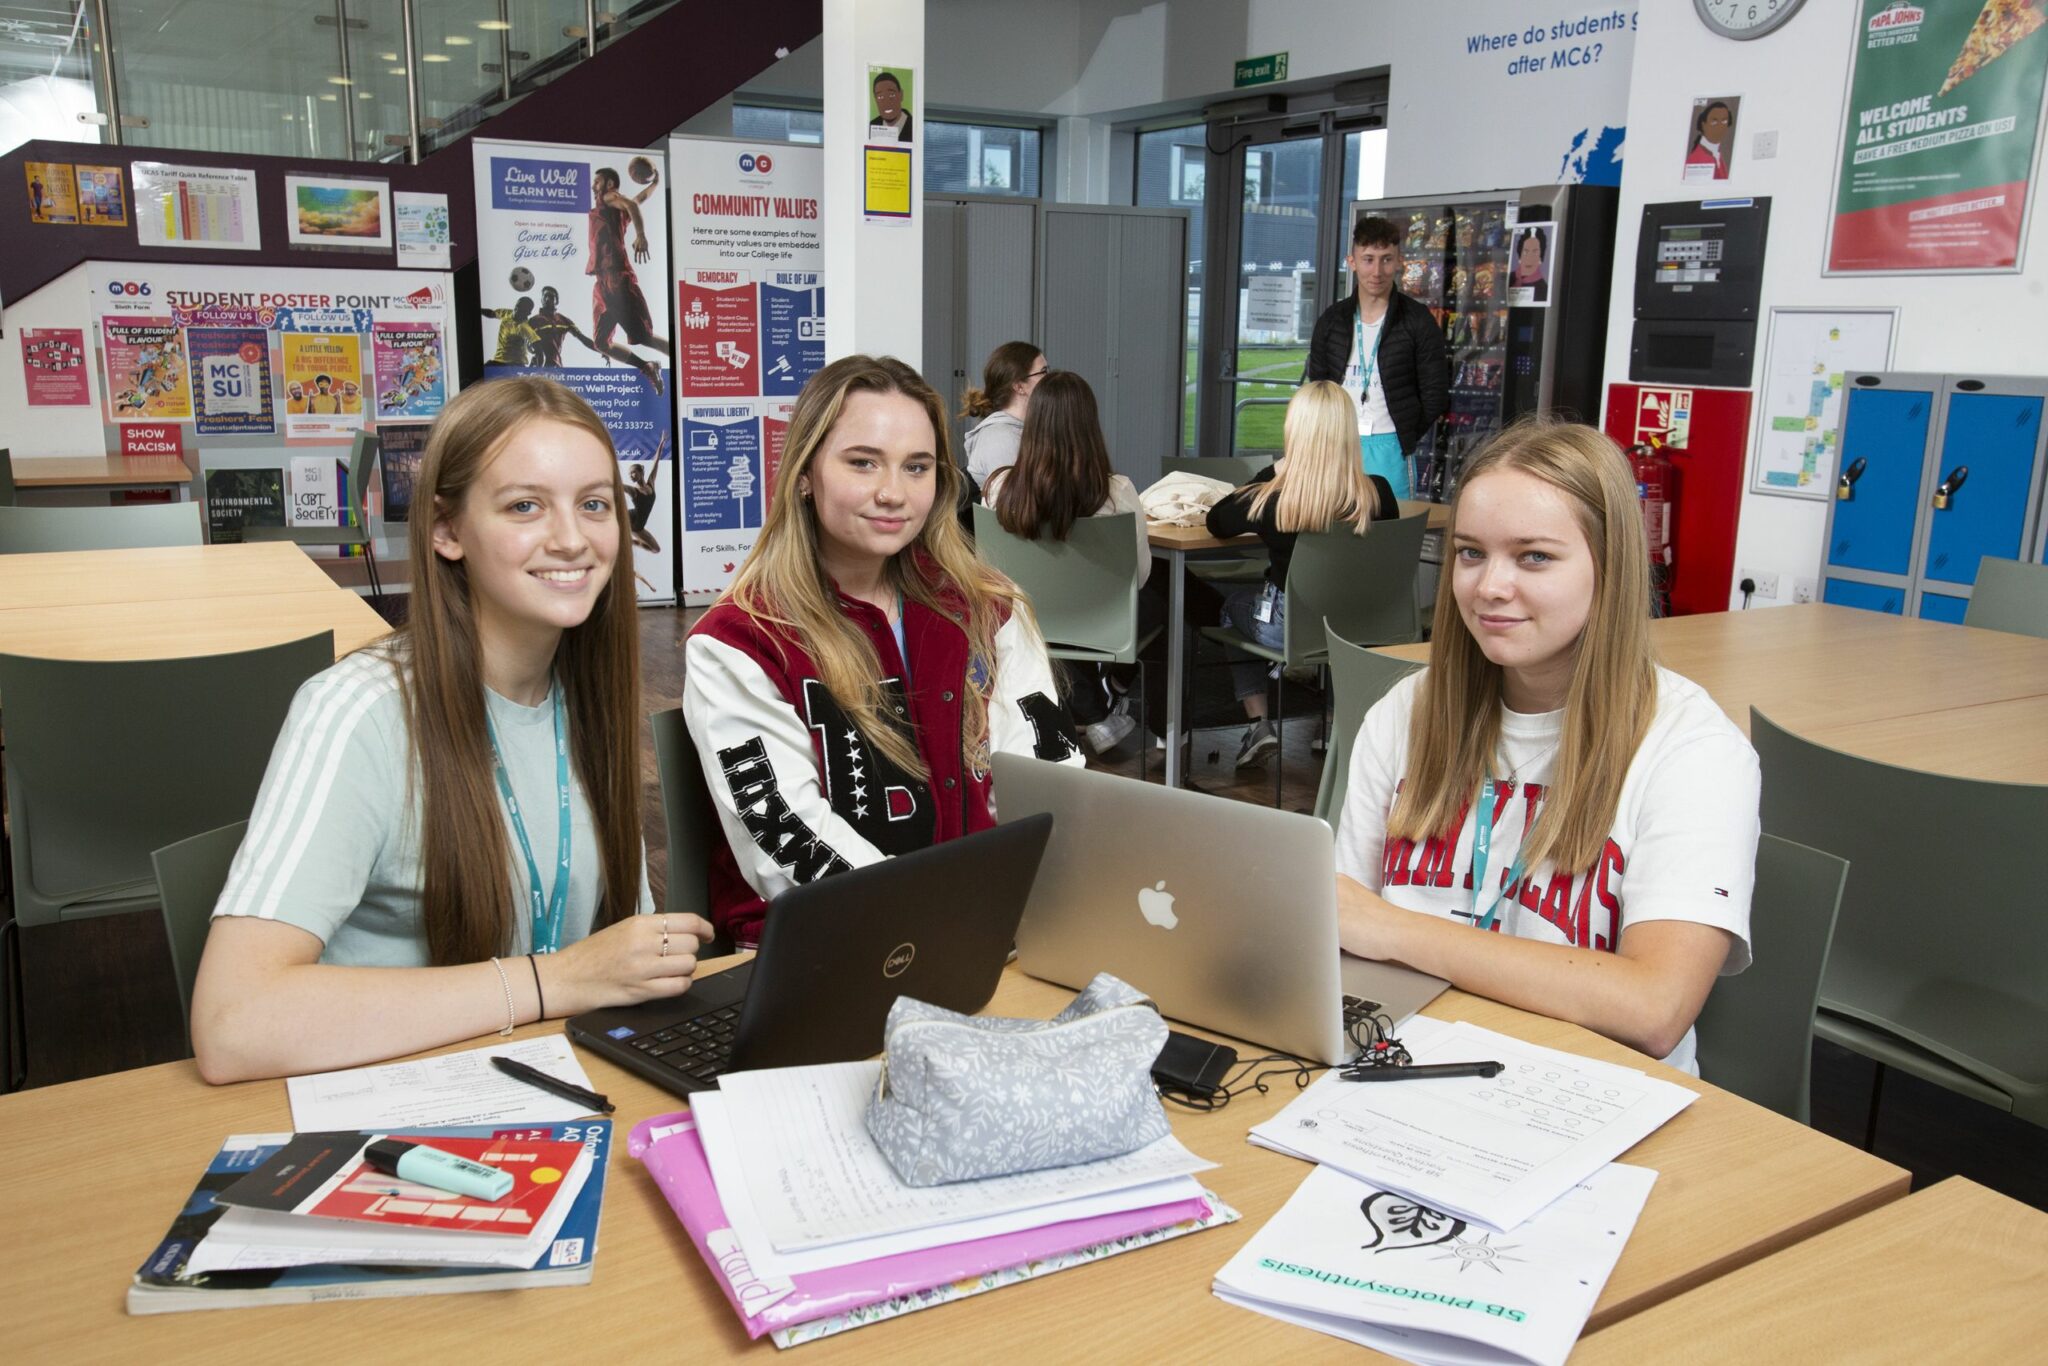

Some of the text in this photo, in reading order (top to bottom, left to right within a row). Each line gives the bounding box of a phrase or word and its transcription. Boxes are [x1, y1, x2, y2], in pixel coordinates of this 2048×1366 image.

[1730, 4, 1738, 18] 7
[1748, 5, 1757, 20] 6
[1871, 12, 1891, 29] PAPA
[1467, 33, 1518, 54] Where
[1523, 25, 1545, 44] do
[1550, 10, 1625, 40] students
[1867, 36, 1894, 49] BETTER
[1508, 43, 1603, 76] after MC6?
[1237, 63, 1270, 80] Fire exit
[1859, 94, 1933, 127] WELCOME
[1856, 105, 1968, 146] ALL STUDENTS
[1857, 147, 1878, 162] HAVE
[1879, 146, 1887, 158] A
[1887, 141, 1909, 157] FREE
[1910, 133, 1947, 151] MEDIUM
[1948, 127, 1975, 144] PIZZA
[1977, 124, 1991, 138] ON
[179, 171, 197, 179] Quick
[504, 166, 578, 186] Live Well
[505, 186, 578, 199] LEARN WELL
[693, 193, 817, 220] COMMUNITY VALUES
[518, 228, 572, 243] Come and
[693, 226, 713, 235] Here
[752, 230, 790, 239] examples
[791, 230, 799, 238] of
[690, 238, 735, 248] community
[778, 242, 820, 250] embedded
[514, 243, 577, 262] Give it a Go
[720, 250, 735, 258] into
[751, 250, 779, 261] College
[780, 250, 793, 259] life
[697, 271, 738, 284] DEMOCRACY
[776, 272, 818, 285] RULE OF LAW
[166, 290, 391, 310] STUDENT POSTER POINT
[196, 312, 253, 320] FOLLOW US
[304, 345, 322, 353] LITTLE
[324, 346, 344, 354] YELLOW
[210, 364, 240, 378] MC
[329, 364, 352, 373] PEOPLE
[550, 374, 566, 382] out
[592, 373, 620, 382] about
[621, 374, 636, 382] the
[212, 380, 242, 397] SU
[585, 384, 606, 393] Well
[614, 398, 630, 408] Pod
[692, 407, 750, 418] INDIVIDUAL LIBERTY
[624, 422, 654, 430] 333725
[126, 428, 166, 439] SHOW
[128, 442, 176, 452] RACISM
[616, 448, 642, 456] .ac.uk
[304, 474, 318, 482] SU
[210, 496, 273, 507] ENVIRONMENTAL
[294, 492, 326, 507] LGBT
[211, 508, 243, 518] SOCIETY
[716, 544, 737, 553] Skills,
[886, 952, 911, 969] DELL
[1260, 1257, 1525, 1323] 5B Photosynthesis
